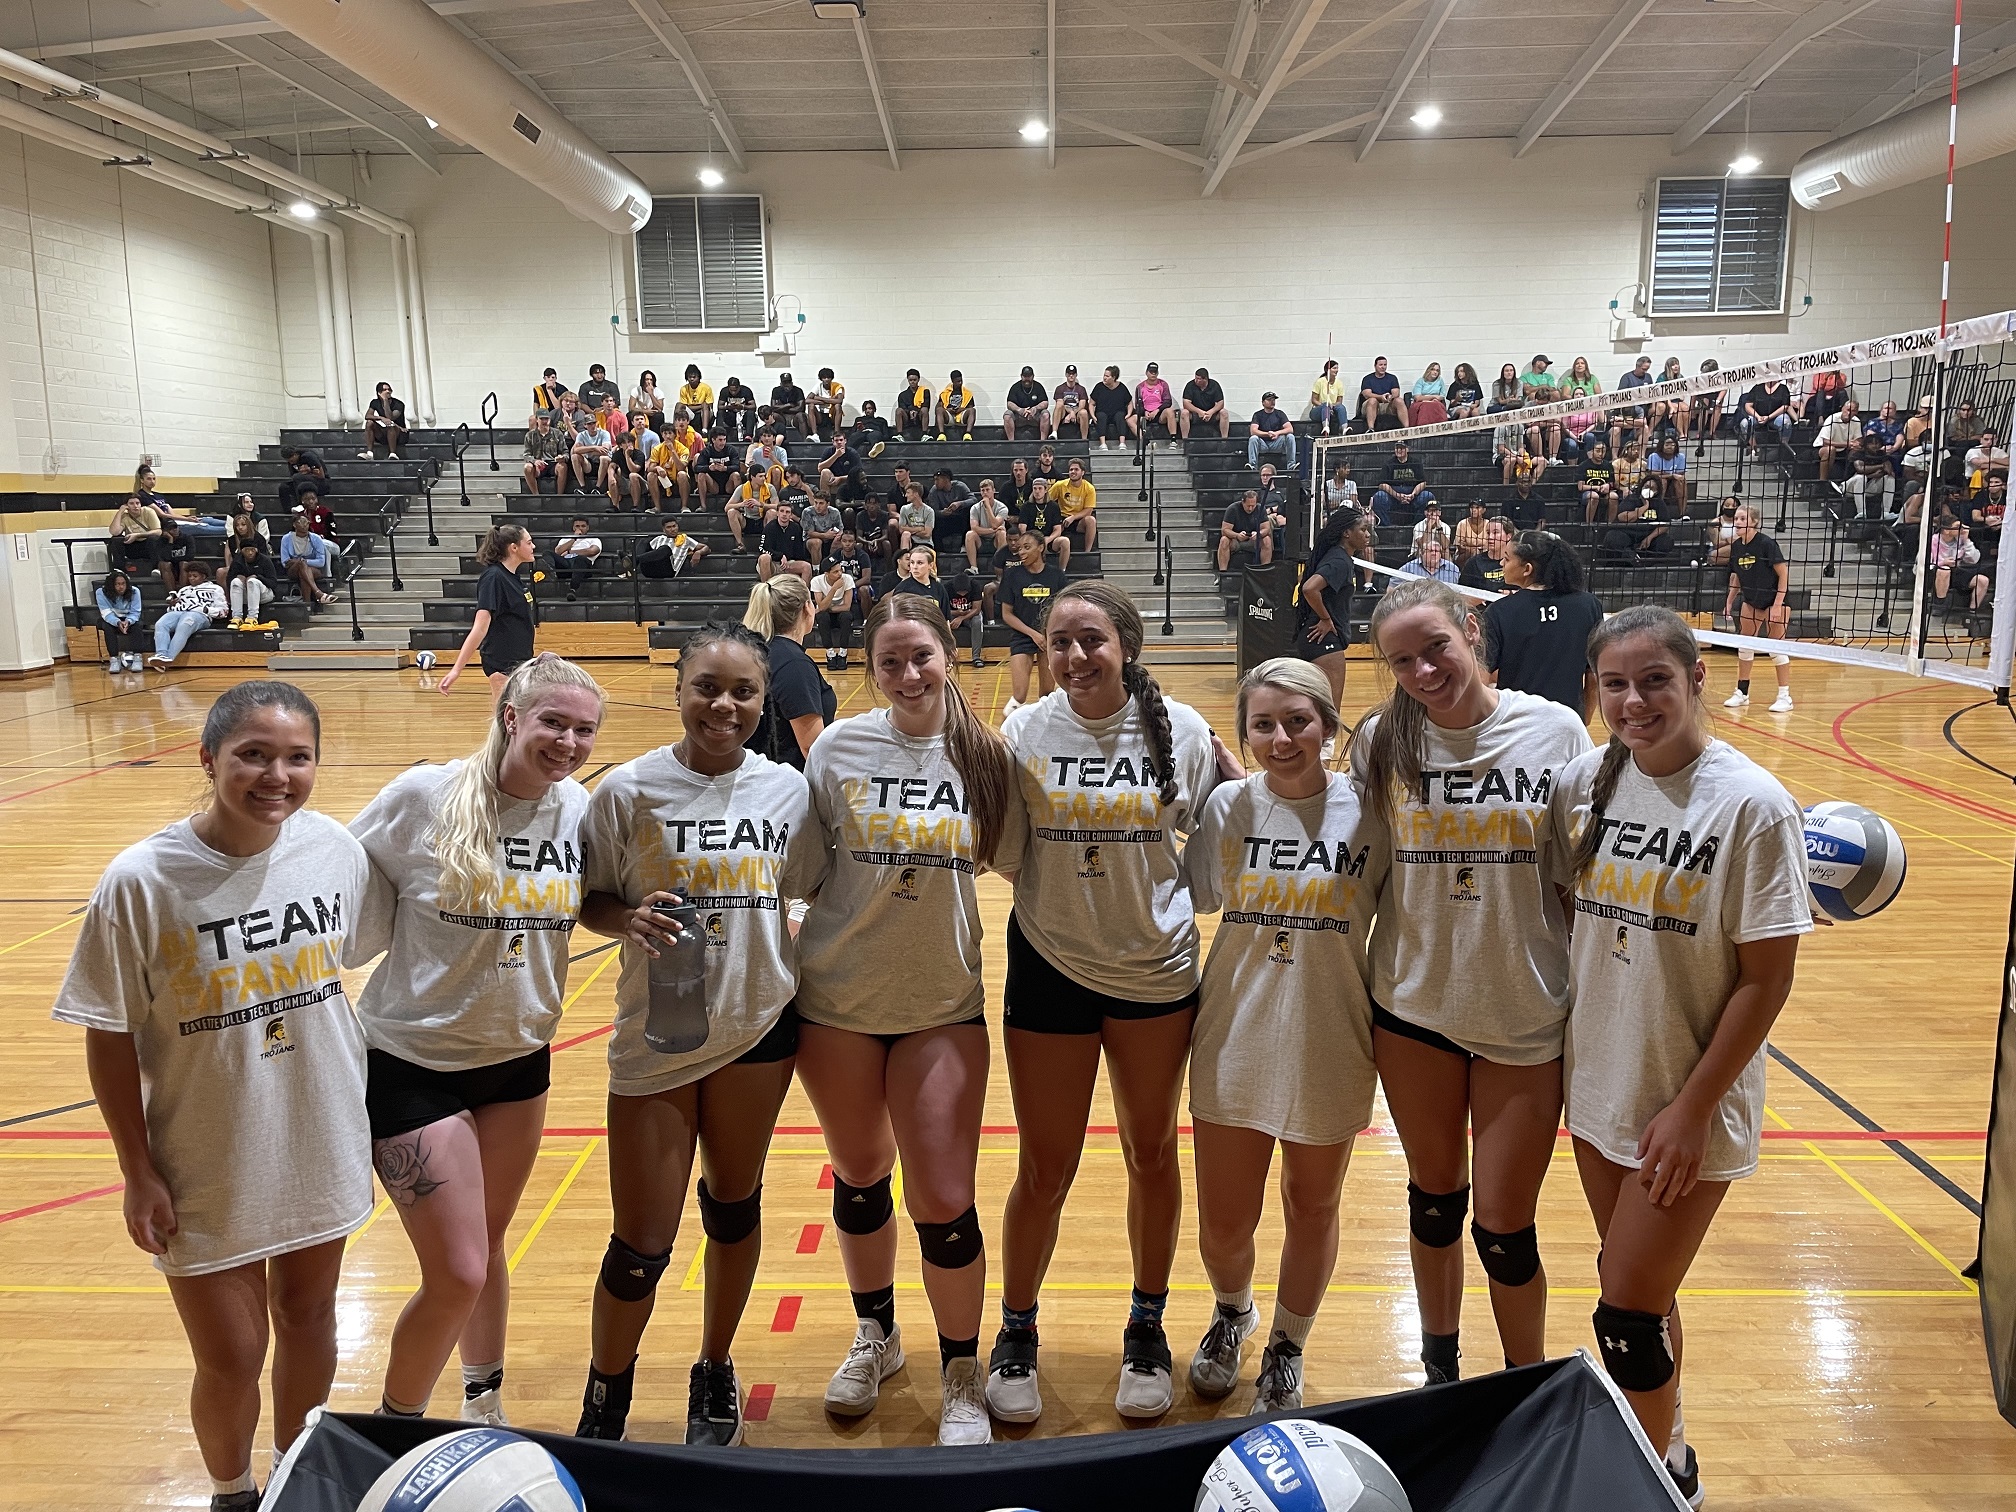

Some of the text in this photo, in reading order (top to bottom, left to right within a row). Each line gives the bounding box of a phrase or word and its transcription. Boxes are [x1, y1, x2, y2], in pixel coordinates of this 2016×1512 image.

[1798, 350, 1838, 370] TROJANS
[1722, 366, 1756, 384] TROJANS
[1661, 380, 1688, 396] TROJANS
[1565, 400, 1584, 412] TROJANS
[1609, 392, 1632, 405] TROJANS
[1248, 604, 1273, 620] SPALDING
[1539, 606, 1558, 622] 13
[1420, 768, 1552, 804] TEAM
[1049, 791, 1164, 827] FAMILY
[666, 818, 789, 856] TEAM
[1072, 830, 1090, 842] TECH
[1092, 830, 1135, 842] COMMUNITY
[1412, 808, 1546, 846] FAMILY
[498, 836, 588, 875] EAM
[1594, 818, 1720, 875] TEAM
[891, 854, 908, 865] TECH
[910, 854, 951, 869] COMMUNITY
[1244, 836, 1370, 878] TEAM
[1443, 852, 1462, 863] TECH
[1464, 852, 1513, 863] COMMUNITY
[666, 856, 781, 893] FAMILY
[474, 875, 582, 914] AMIL
[1240, 874, 1360, 915] FAMILY
[1579, 860, 1706, 914] FAMLY
[696, 897, 712, 908] TECH
[715, 896, 759, 908] COMMUNITY
[1450, 894, 1482, 902] TROJANS
[444, 914, 497, 929] FAYETTEVILLE
[499, 918, 517, 929] TECH
[1264, 914, 1281, 926] TECH
[1602, 904, 1621, 919] TECH
[197, 892, 342, 961] TEAM
[1268, 954, 1294, 966] TROJANS
[209, 936, 343, 1009] FAMILY
[184, 1012, 247, 1035] FAYETTEVILLE
[249, 1002, 270, 1019] TECH
[273, 988, 324, 1013] COMMUNITY
[260, 1044, 295, 1060] TROJANS
[405, 1433, 490, 1497] TACHIKARA
[1241, 1426, 1302, 1494] molte
